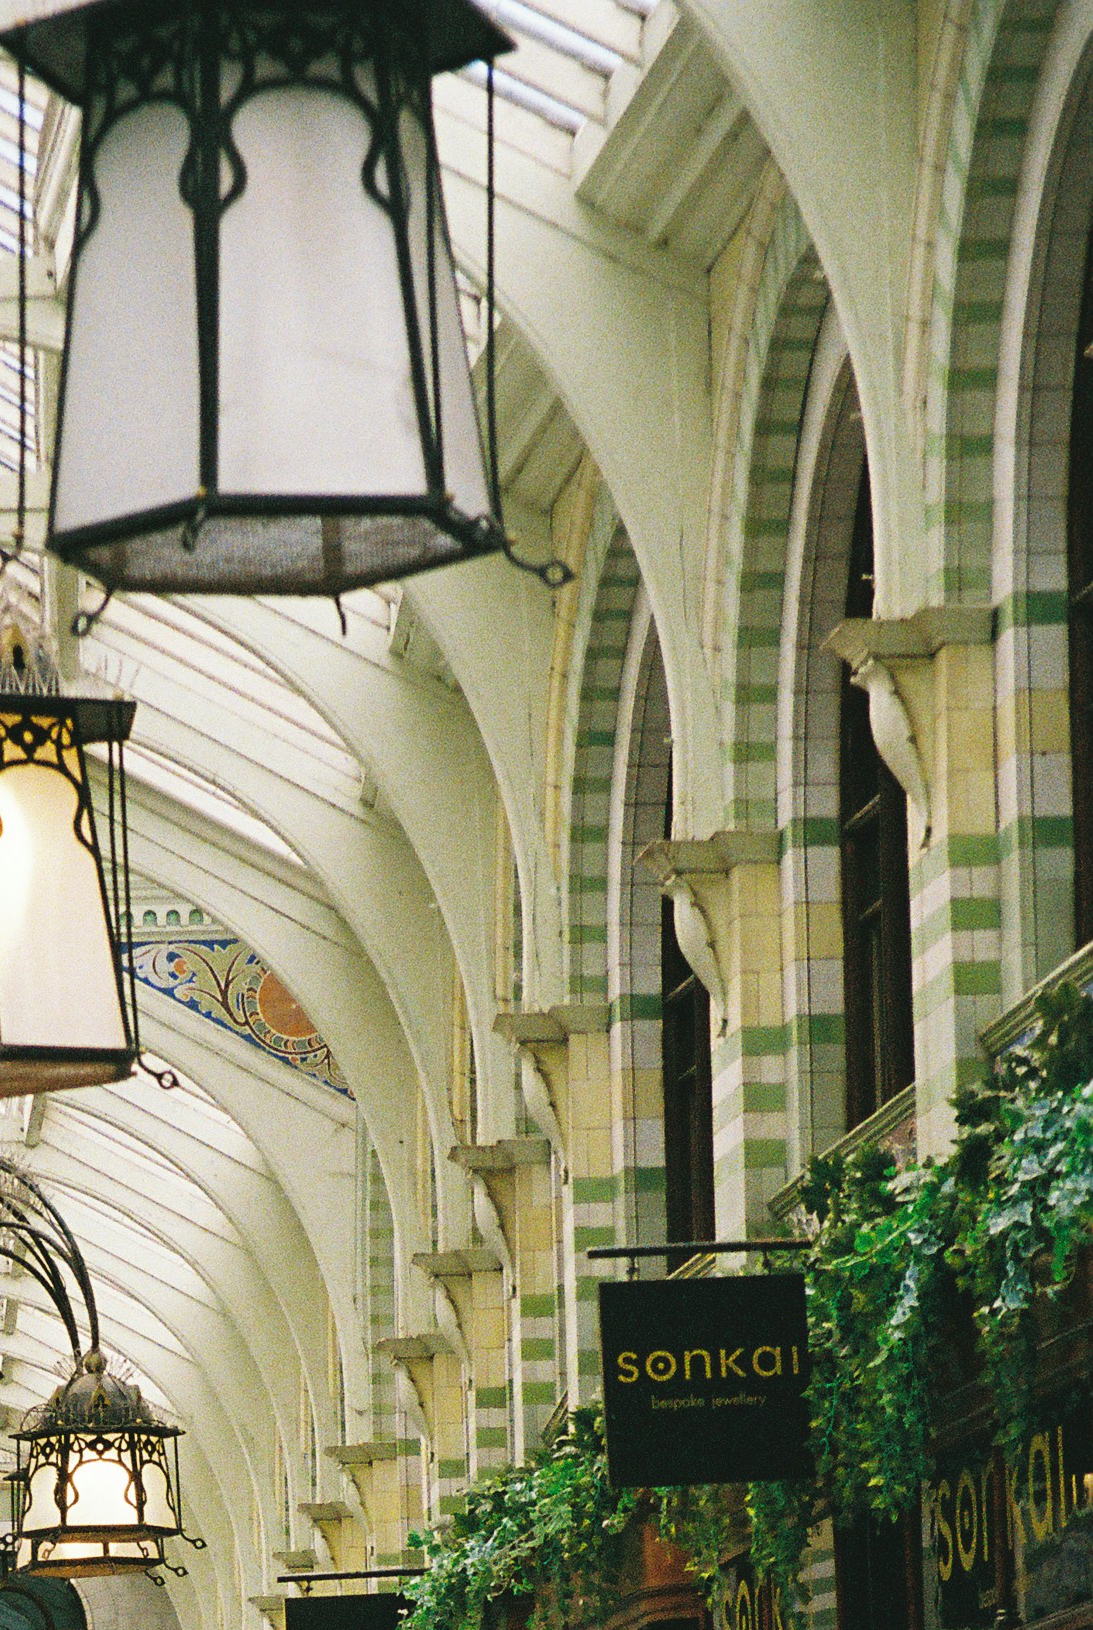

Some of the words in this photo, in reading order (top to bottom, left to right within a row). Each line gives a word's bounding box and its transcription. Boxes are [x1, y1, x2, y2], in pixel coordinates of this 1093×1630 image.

[617, 1345, 800, 1384] sonkai
[651, 1393, 706, 1411] bespoke
[711, 1391, 767, 1409] jewellery
